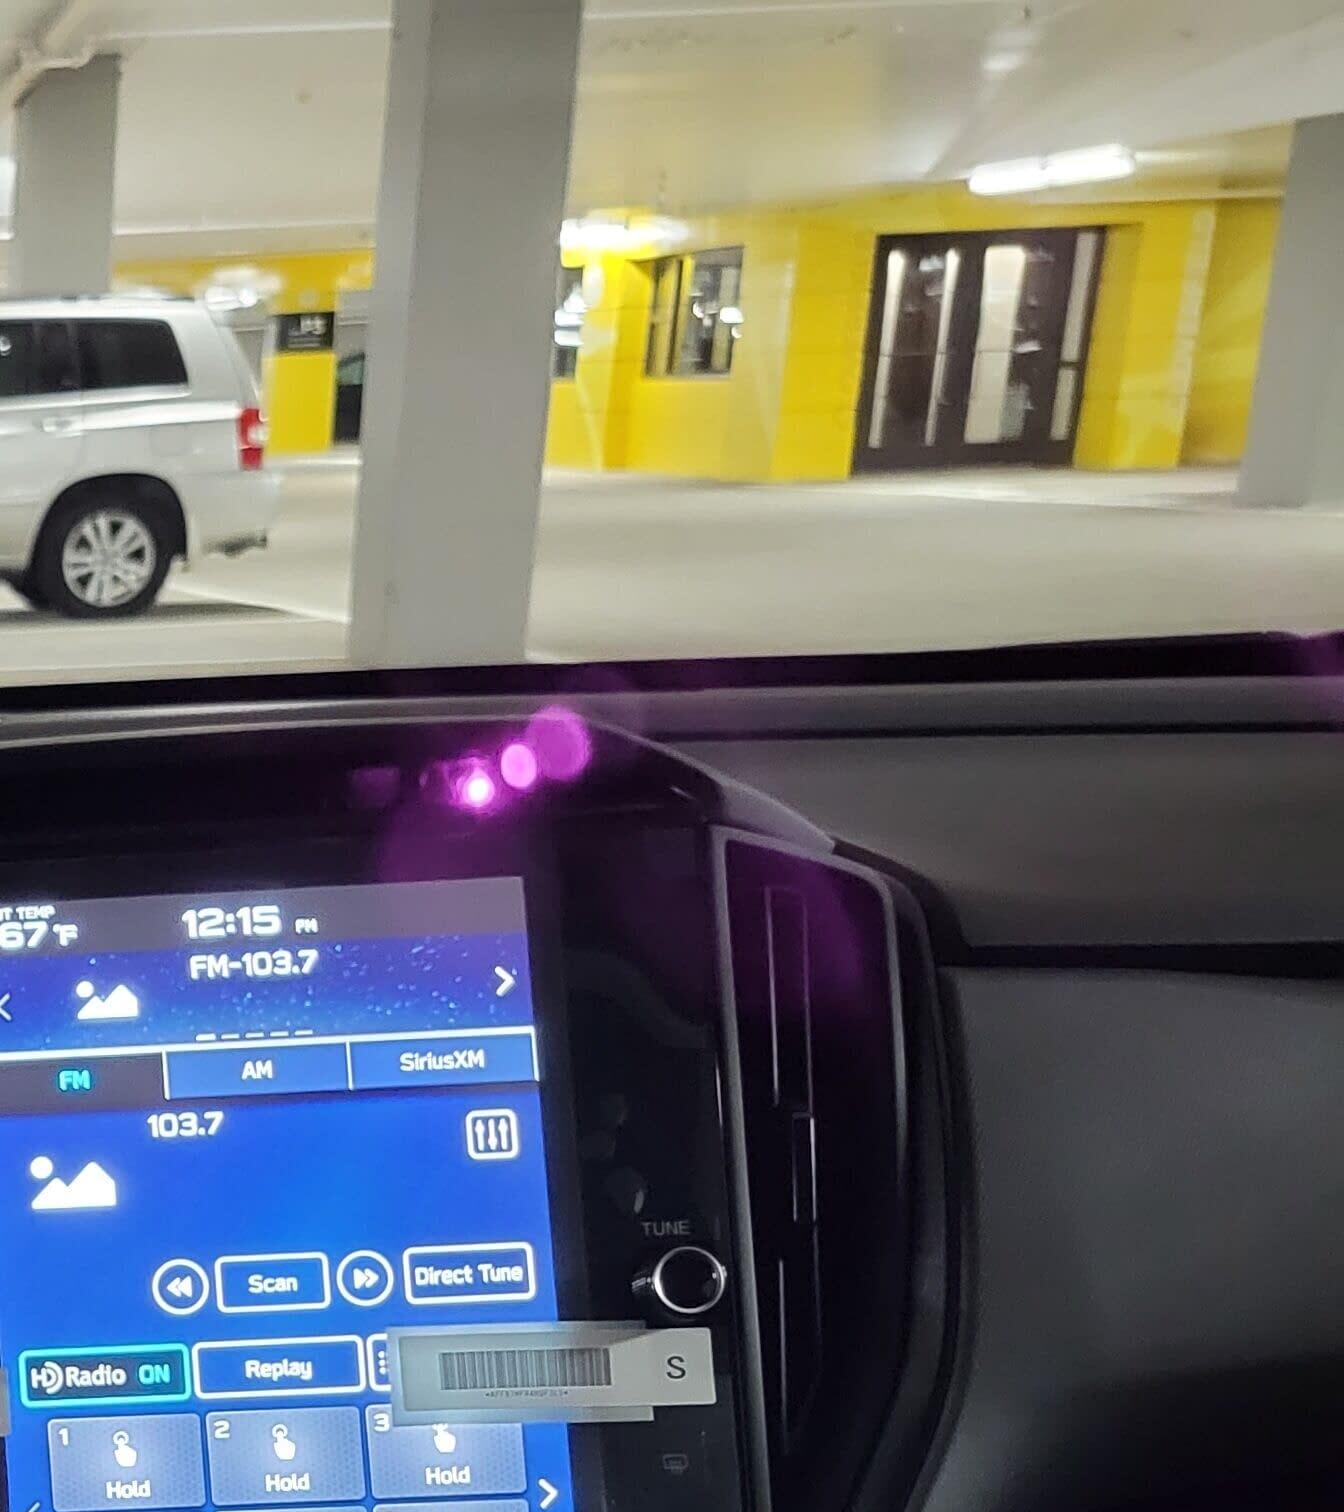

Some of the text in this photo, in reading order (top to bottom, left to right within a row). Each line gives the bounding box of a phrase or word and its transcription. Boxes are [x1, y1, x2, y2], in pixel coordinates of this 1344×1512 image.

[16, 905, 56, 919] TEMP
[181, 905, 318, 939] 12:15 PM
[189, 949, 319, 980] FM-103.7
[241, 1061, 273, 1081] AM
[399, 1051, 485, 1074] SiriusXM
[58, 1072, 90, 1092] FM
[147, 1112, 224, 1139] 103.7
[641, 1220, 691, 1238] TUNE
[247, 1274, 298, 1294] Scan
[414, 1263, 524, 1286] Direct Tune
[65, 1364, 127, 1388] Radio
[138, 1364, 171, 1385] ON
[244, 1358, 313, 1382] Replay
[666, 1356, 687, 1379] S
[214, 1420, 231, 1438] 2
[373, 1413, 390, 1432] 3
[58, 1428, 70, 1446] 1
[264, 1474, 311, 1493] Hold
[425, 1466, 471, 1486] Hold
[105, 1480, 152, 1499] Hold
